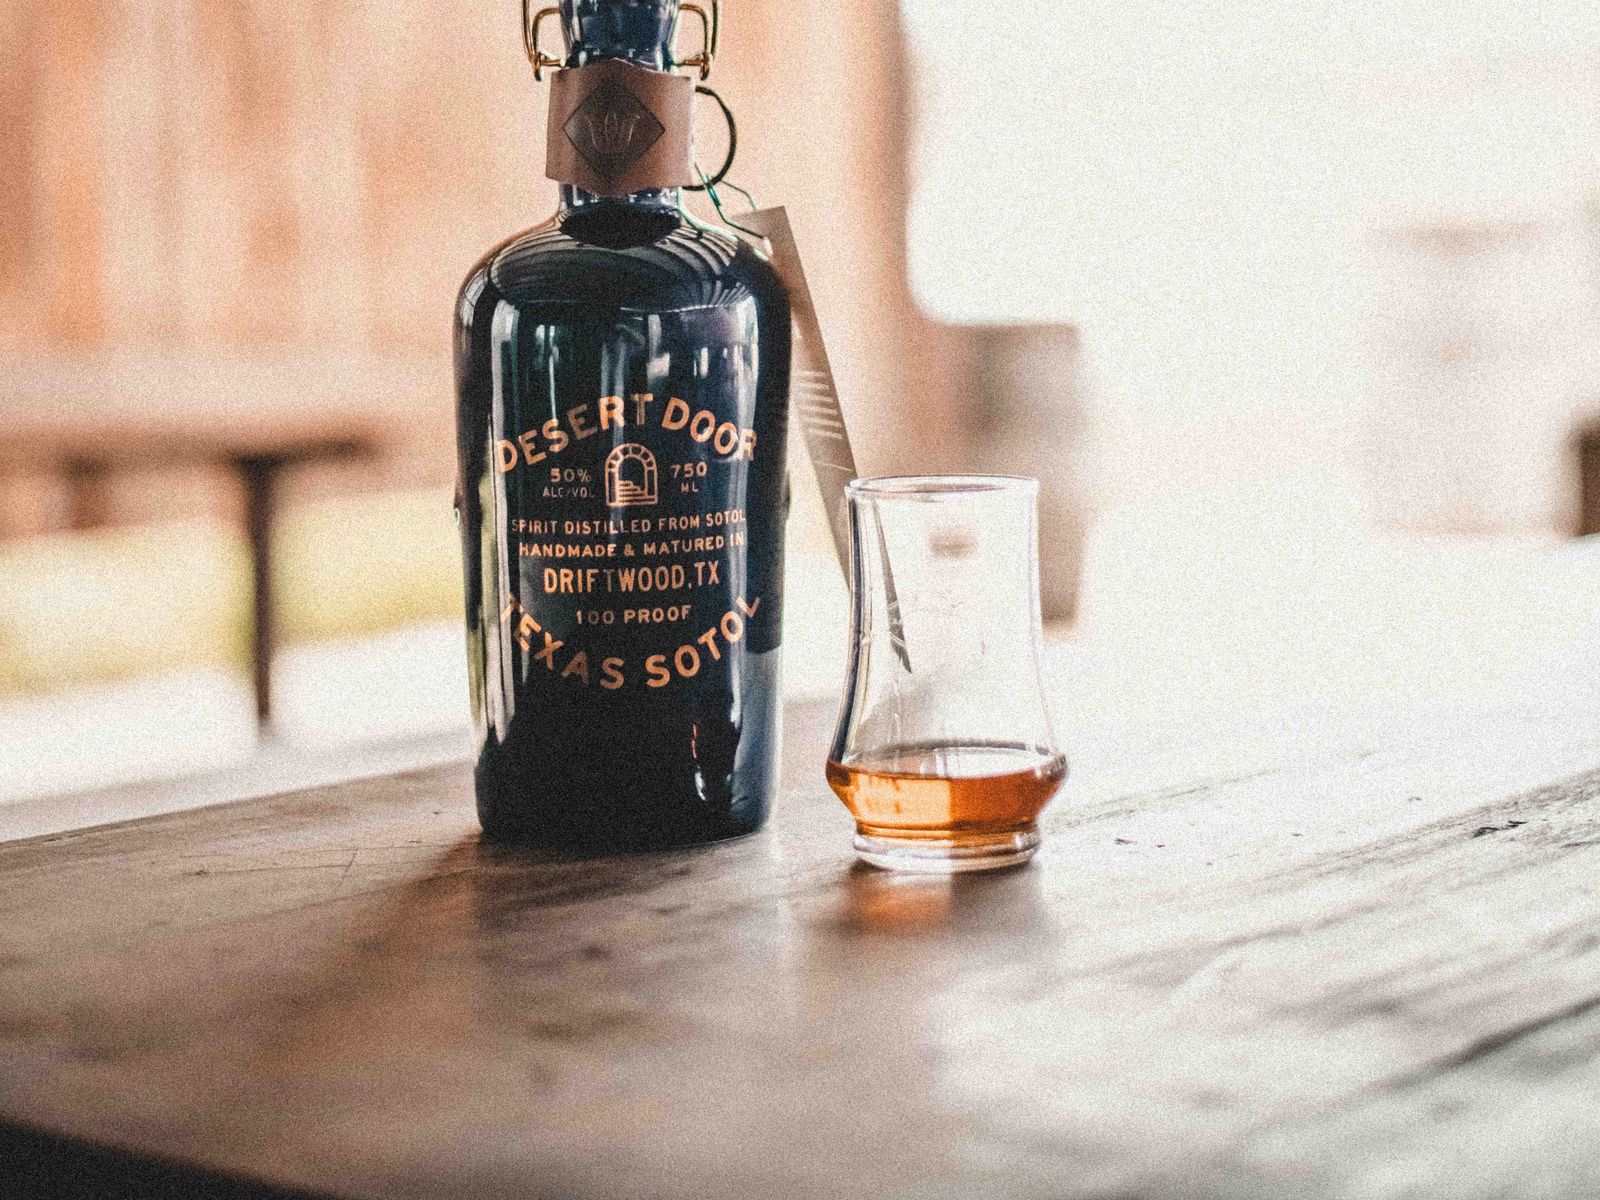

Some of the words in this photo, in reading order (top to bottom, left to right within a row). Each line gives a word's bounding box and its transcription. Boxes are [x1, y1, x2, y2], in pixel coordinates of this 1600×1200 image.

[497, 393, 654, 473] DESERT
[661, 396, 758, 461] DOOR
[550, 467, 592, 483] 50%
[671, 461, 708, 479] 750
[680, 482, 699, 493] ML
[511, 519, 557, 535] SPIRIT
[564, 519, 651, 535] DISTILLED
[658, 515, 700, 531] FROM
[705, 509, 746, 527] SOTOL
[518, 542, 617, 558] HANDMADE
[623, 543, 635, 557] &
[643, 535, 724, 556] MATURED
[729, 531, 745, 548] IN
[575, 609, 615, 625] 100
[623, 605, 692, 624] PROOF
[500, 593, 625, 689] TEXAS
[645, 596, 760, 688] SOTOL
